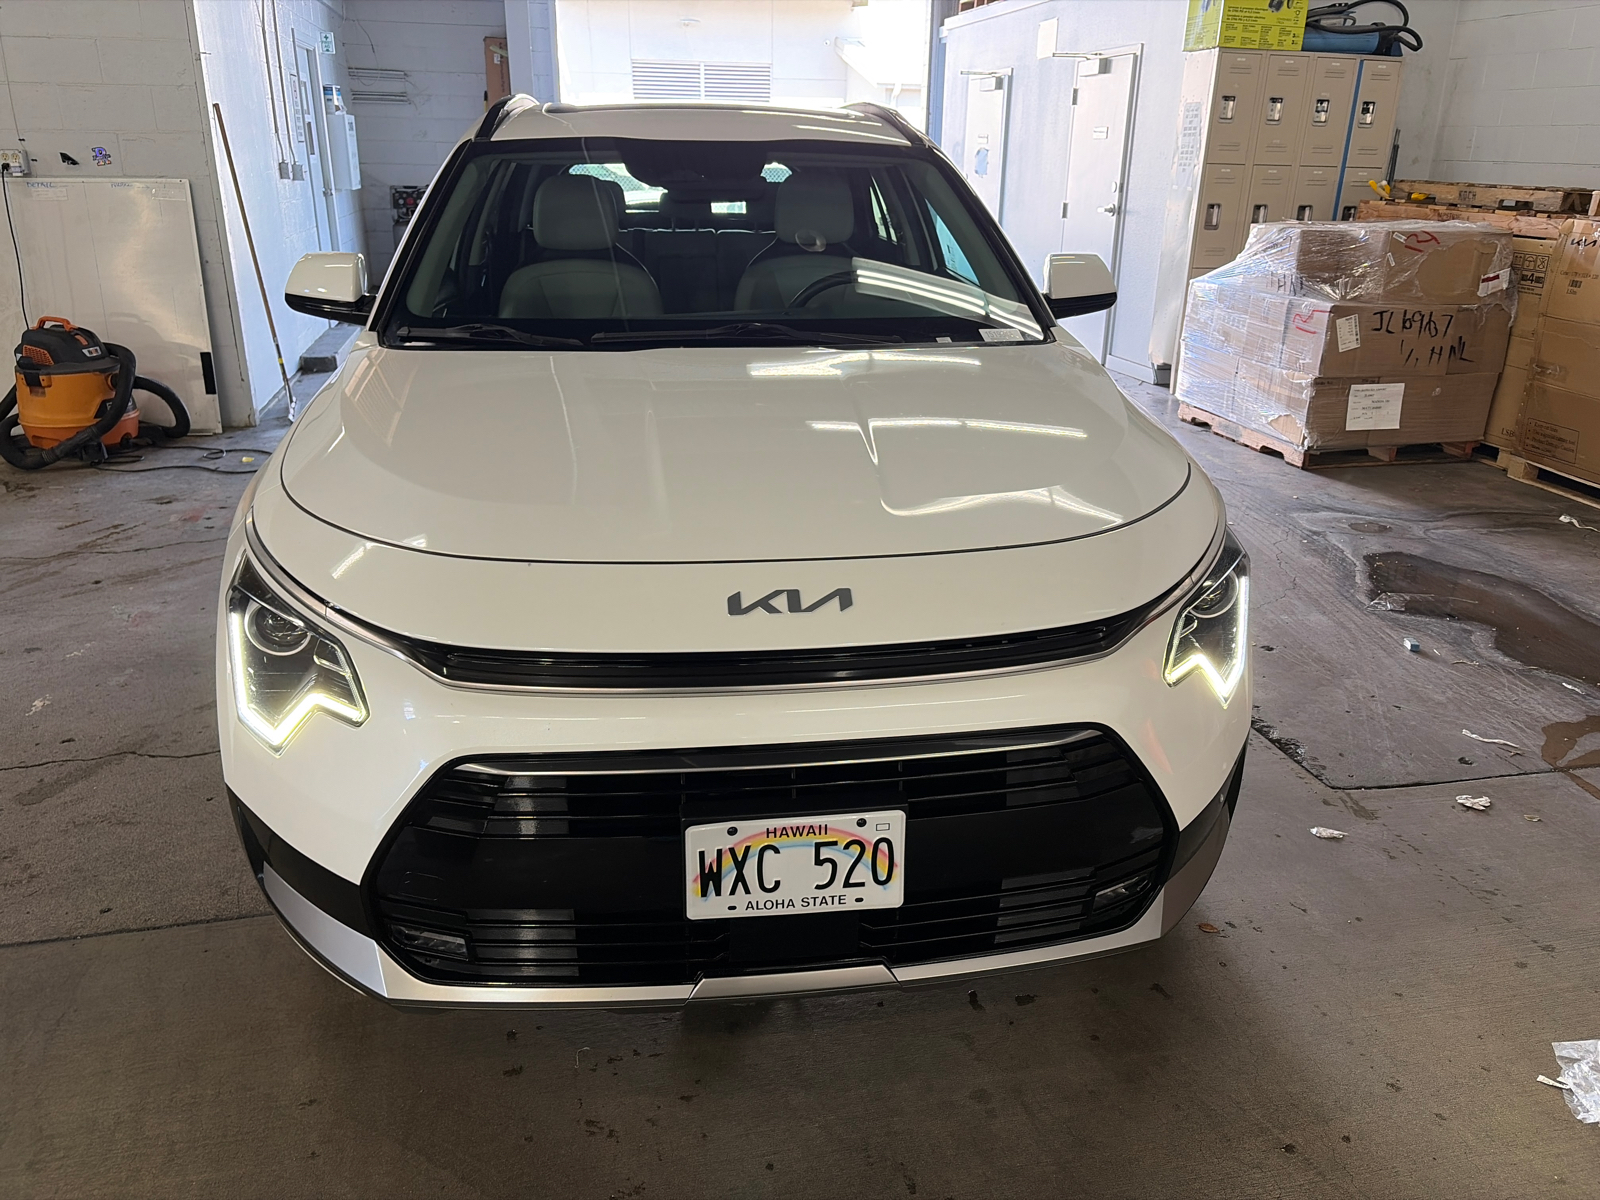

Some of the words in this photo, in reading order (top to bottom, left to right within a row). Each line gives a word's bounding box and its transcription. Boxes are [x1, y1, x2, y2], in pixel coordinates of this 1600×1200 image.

[727, 587, 853, 616] KIA
[765, 824, 829, 839] HAWAII
[698, 844, 781, 897] WXC
[813, 837, 895, 890] 520
[745, 899, 796, 911] ALOHA
[800, 894, 847, 908] STATE
